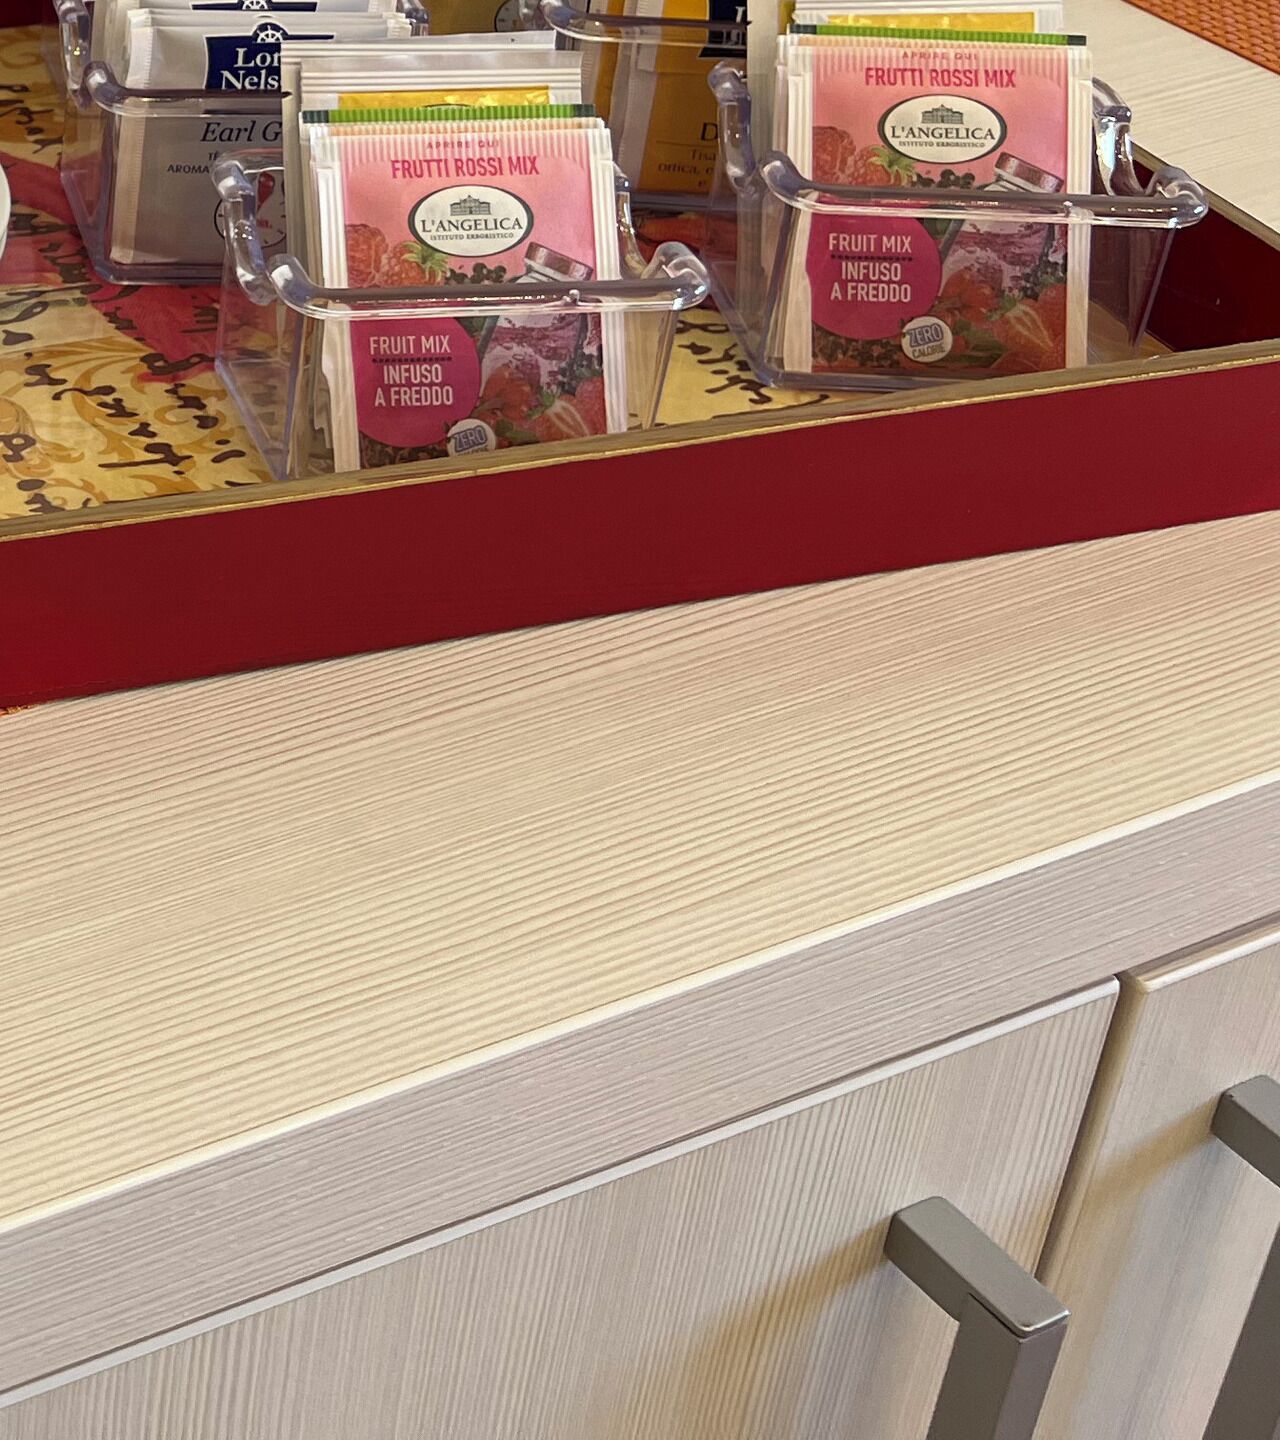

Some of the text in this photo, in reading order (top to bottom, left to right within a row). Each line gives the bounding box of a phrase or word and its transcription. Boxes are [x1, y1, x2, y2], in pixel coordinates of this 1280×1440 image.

[233, 47, 280, 67] Lor
[220, 69, 280, 90] Nels
[864, 67, 1017, 88] FRUTTI ROSSI MIX
[200, 120, 256, 142] Earl
[890, 125, 996, 141] L'ANGELICA
[167, 164, 210, 174] AROMA
[391, 155, 540, 179] FRUTTI ROSSI MIX
[420, 216, 524, 234] L'ANGELICA
[828, 232, 912, 254] FRUIT MIX
[841, 261, 902, 282] INFUSO
[830, 281, 912, 303] A FREDDO
[369, 334, 452, 355] FRUIT MIX
[908, 323, 944, 348] ZERO
[383, 363, 443, 385] INFUSO
[374, 385, 454, 407] A FREDDO
[453, 425, 487, 452] ZERO
